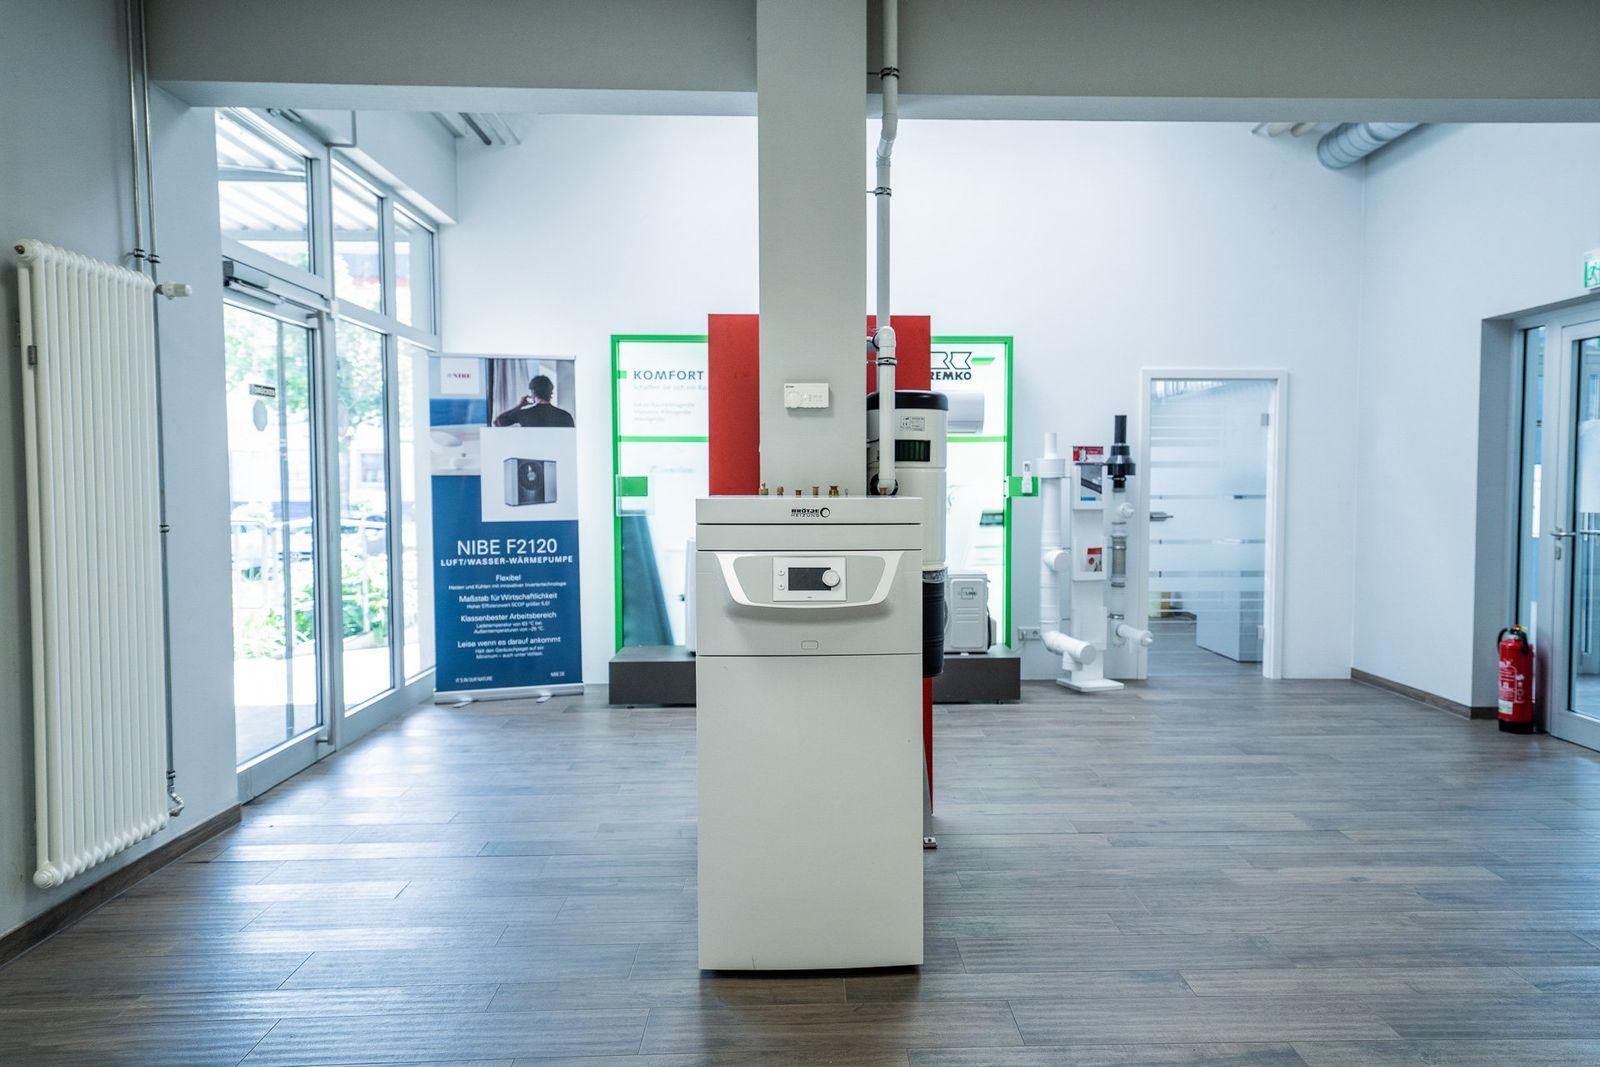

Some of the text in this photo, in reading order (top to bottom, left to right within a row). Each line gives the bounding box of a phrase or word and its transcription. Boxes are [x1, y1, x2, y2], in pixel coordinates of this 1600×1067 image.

[633, 370, 704, 380] KOMFORT
[930, 372, 972, 380] REMKO
[457, 538, 558, 556] NIBE F2120
[440, 555, 574, 567] LUFT/WASSER-WÄRMEPUMPE
[458, 592, 558, 603] Maßstab für Wirtschaftlichkeit
[460, 612, 557, 623] Klassenbester Arbeitsbereich
[457, 640, 478, 649] Leise
[478, 640, 497, 648] wenn
[507, 637, 529, 646] darauf
[530, 636, 562, 644] ankommt
